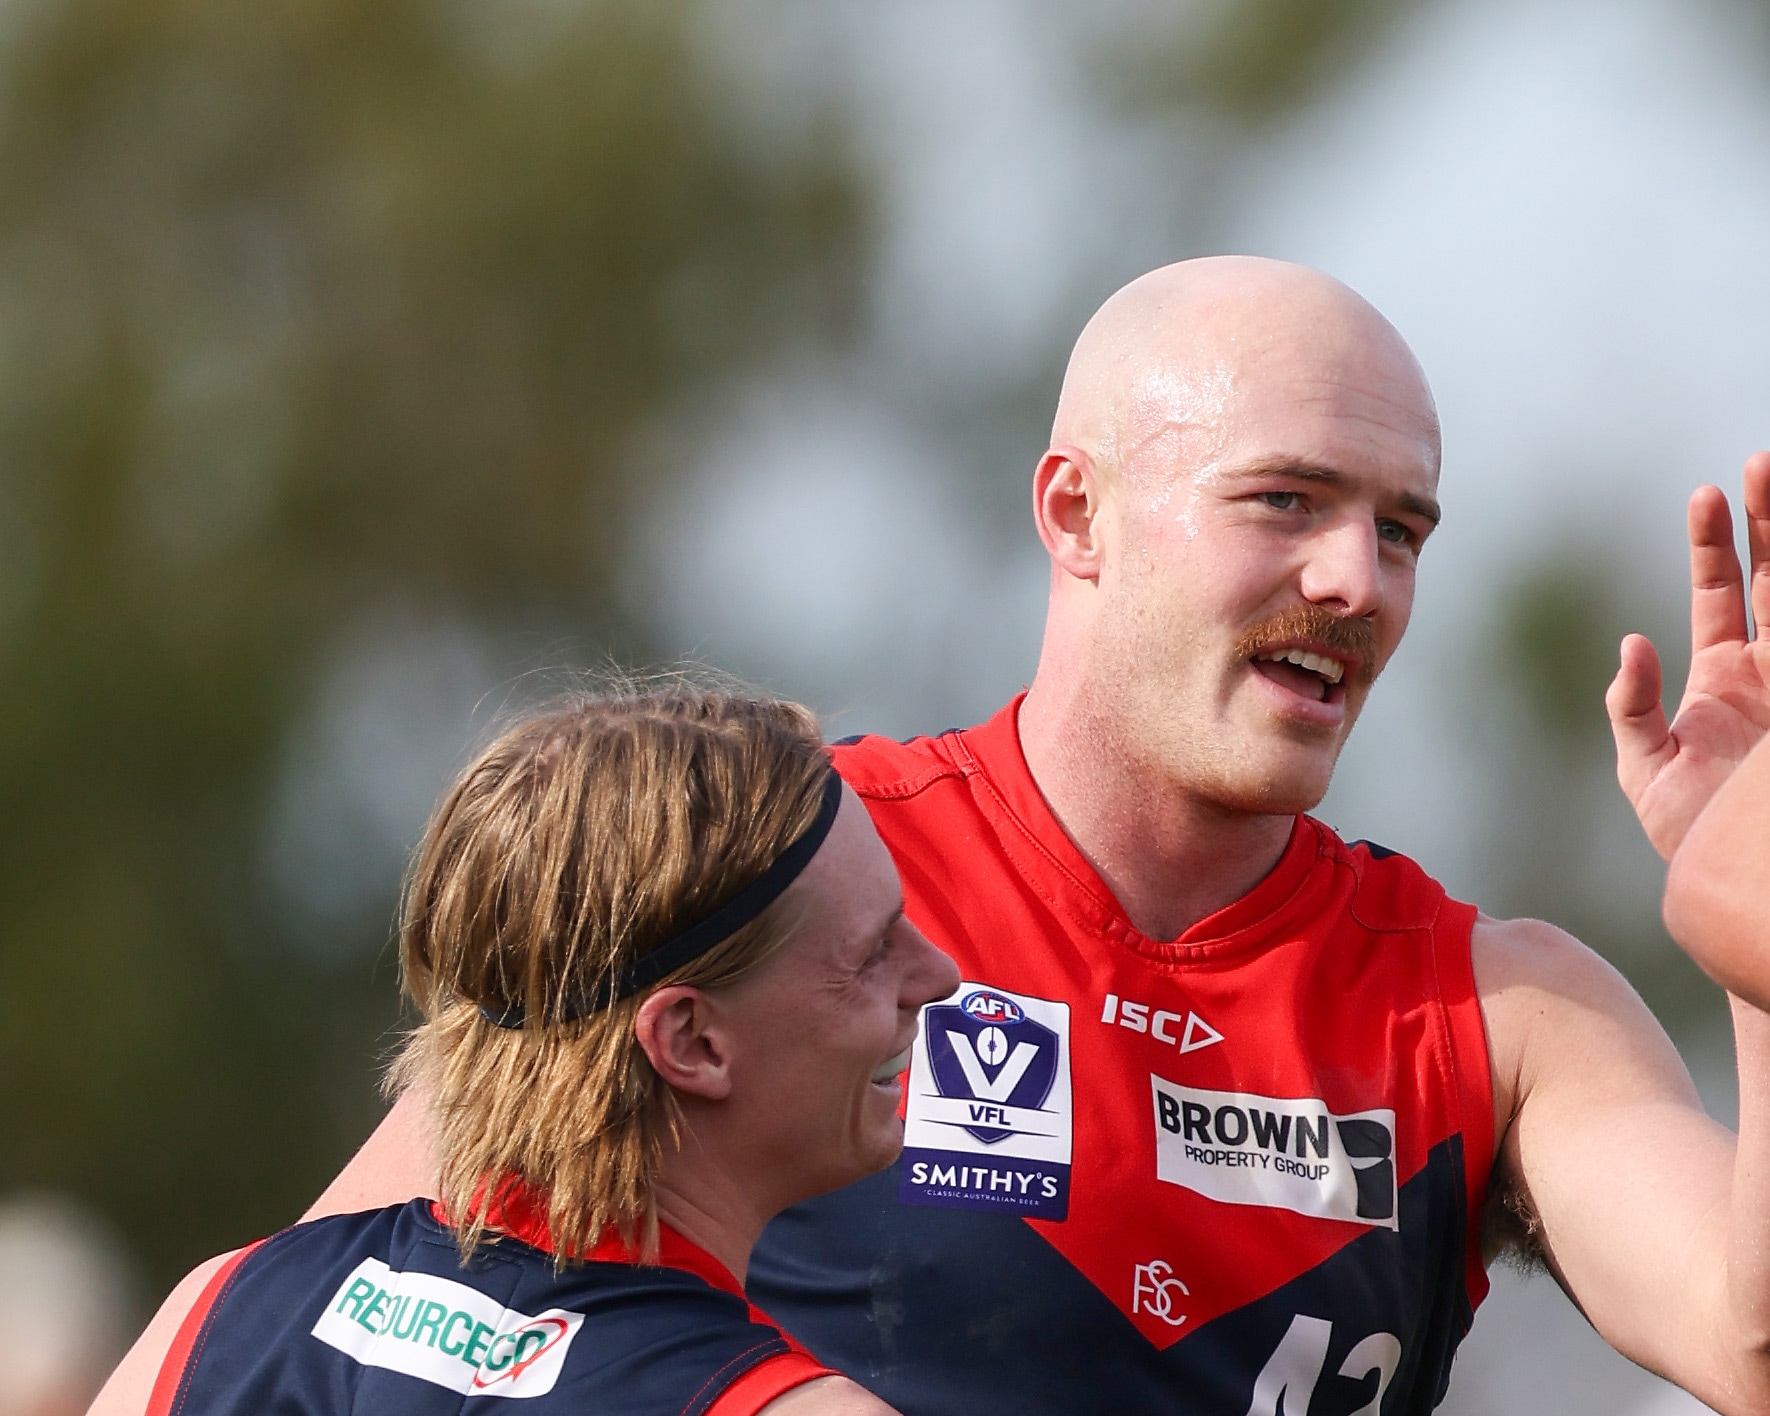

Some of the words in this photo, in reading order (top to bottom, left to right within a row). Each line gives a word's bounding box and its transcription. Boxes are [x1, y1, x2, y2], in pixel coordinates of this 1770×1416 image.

[966, 996, 1020, 1020] AFL
[1100, 993, 1182, 1046] ISC
[969, 1103, 1012, 1126] VFL
[1157, 1089, 1330, 1159] BROWN
[910, 1162, 1059, 1198] SMITHY'S
[1185, 1144, 1271, 1169] PROPERTY
[1274, 1158, 1331, 1182] GROUP
